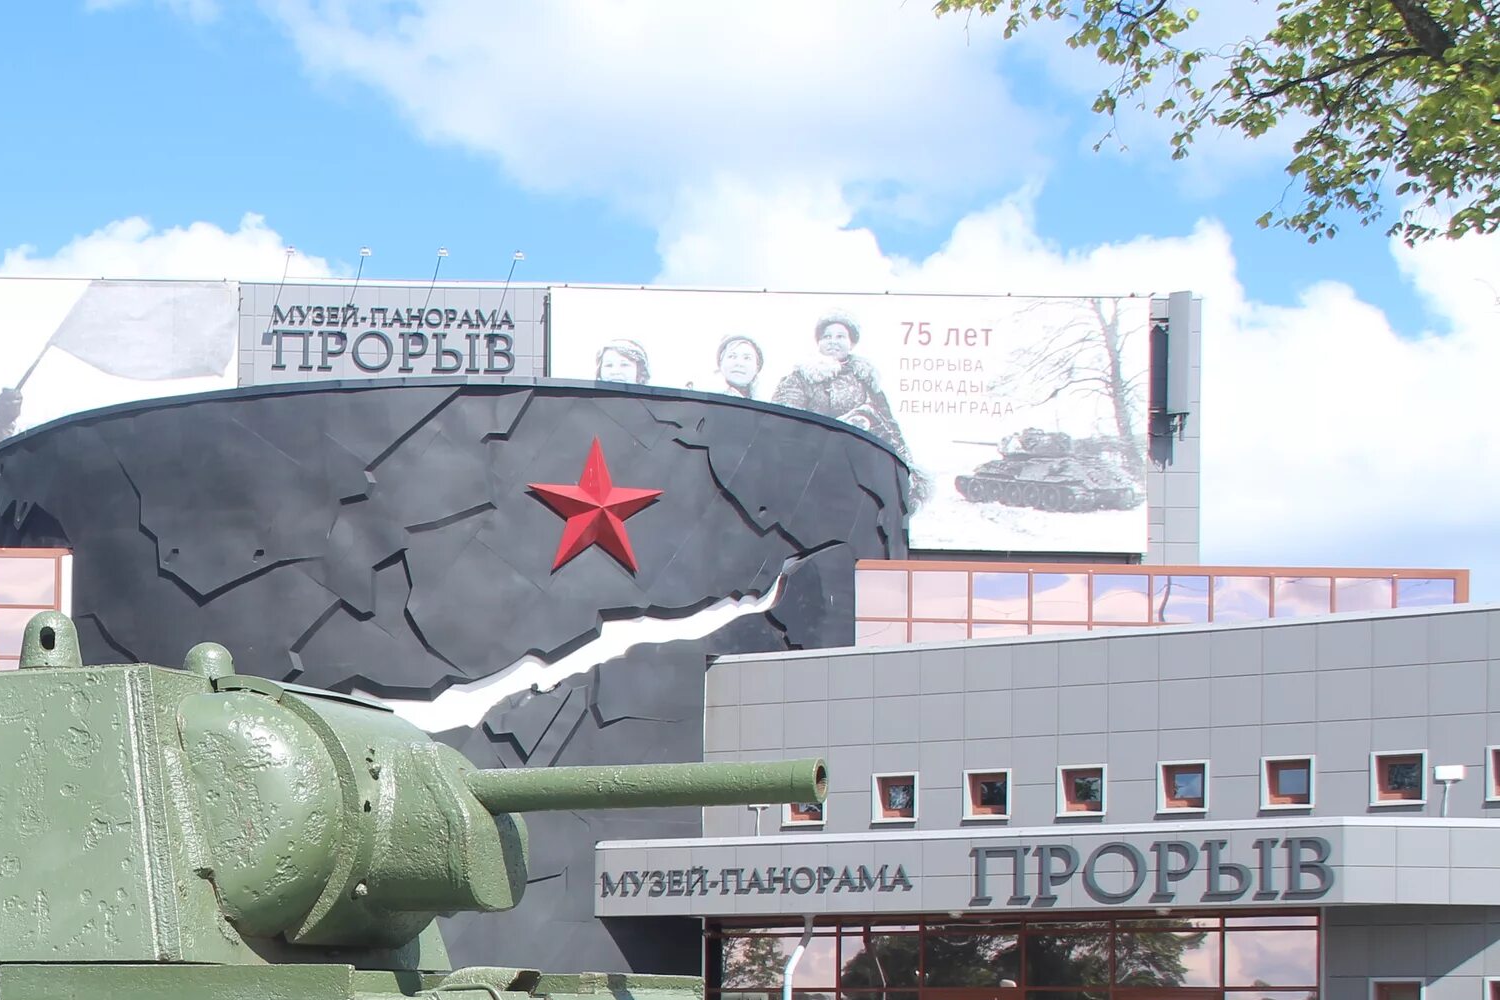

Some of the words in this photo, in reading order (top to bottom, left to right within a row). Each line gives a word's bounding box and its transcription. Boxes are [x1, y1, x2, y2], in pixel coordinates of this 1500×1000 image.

[273, 303, 515, 329] МУЗЕЙ-ПАНОРАМА
[900, 322, 932, 346] 75
[944, 328, 993, 347] лет
[271, 329, 516, 375] ПРОРЫВ
[899, 358, 984, 372] ПРОРЫВА
[900, 379, 984, 395] БЛОКАДЫ
[899, 400, 1014, 417] ЛЕНИНГРАДА
[600, 864, 913, 898] МУЗЕЙ-ПАНОРАМА
[968, 836, 1335, 907] ПРОРЫВ
